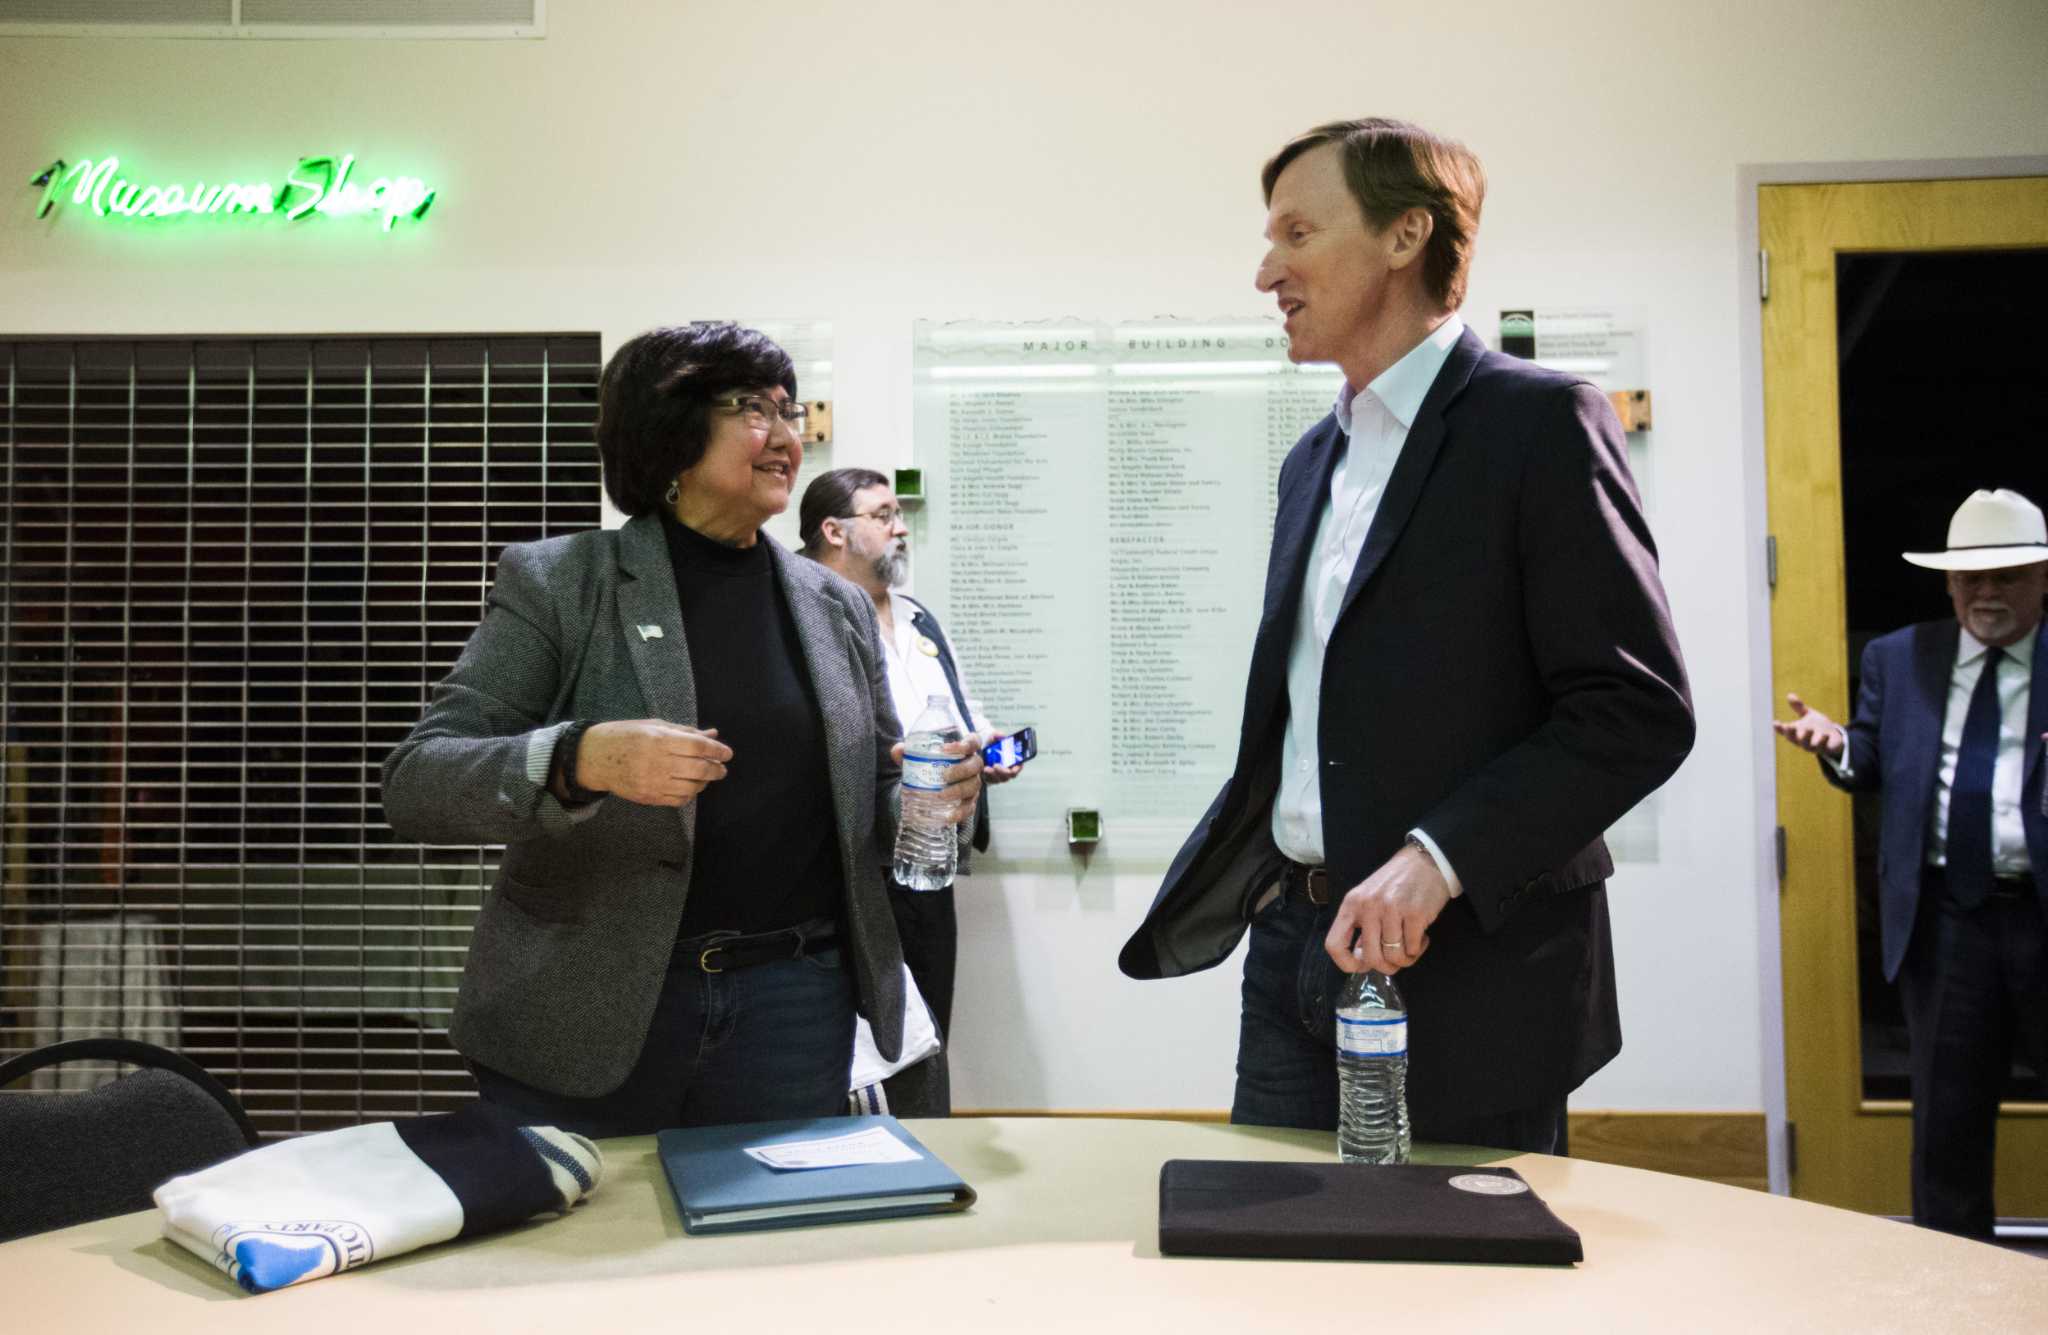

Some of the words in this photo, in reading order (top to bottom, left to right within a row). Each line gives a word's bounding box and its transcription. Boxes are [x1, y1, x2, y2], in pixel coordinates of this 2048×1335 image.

[64, 156, 274, 217] Museum
[286, 154, 428, 232] Shop
[1023, 340, 1089, 352] MAJOR
[1128, 338, 1227, 350] BUILDING
[1109, 535, 1165, 544] BENEFACTOR
